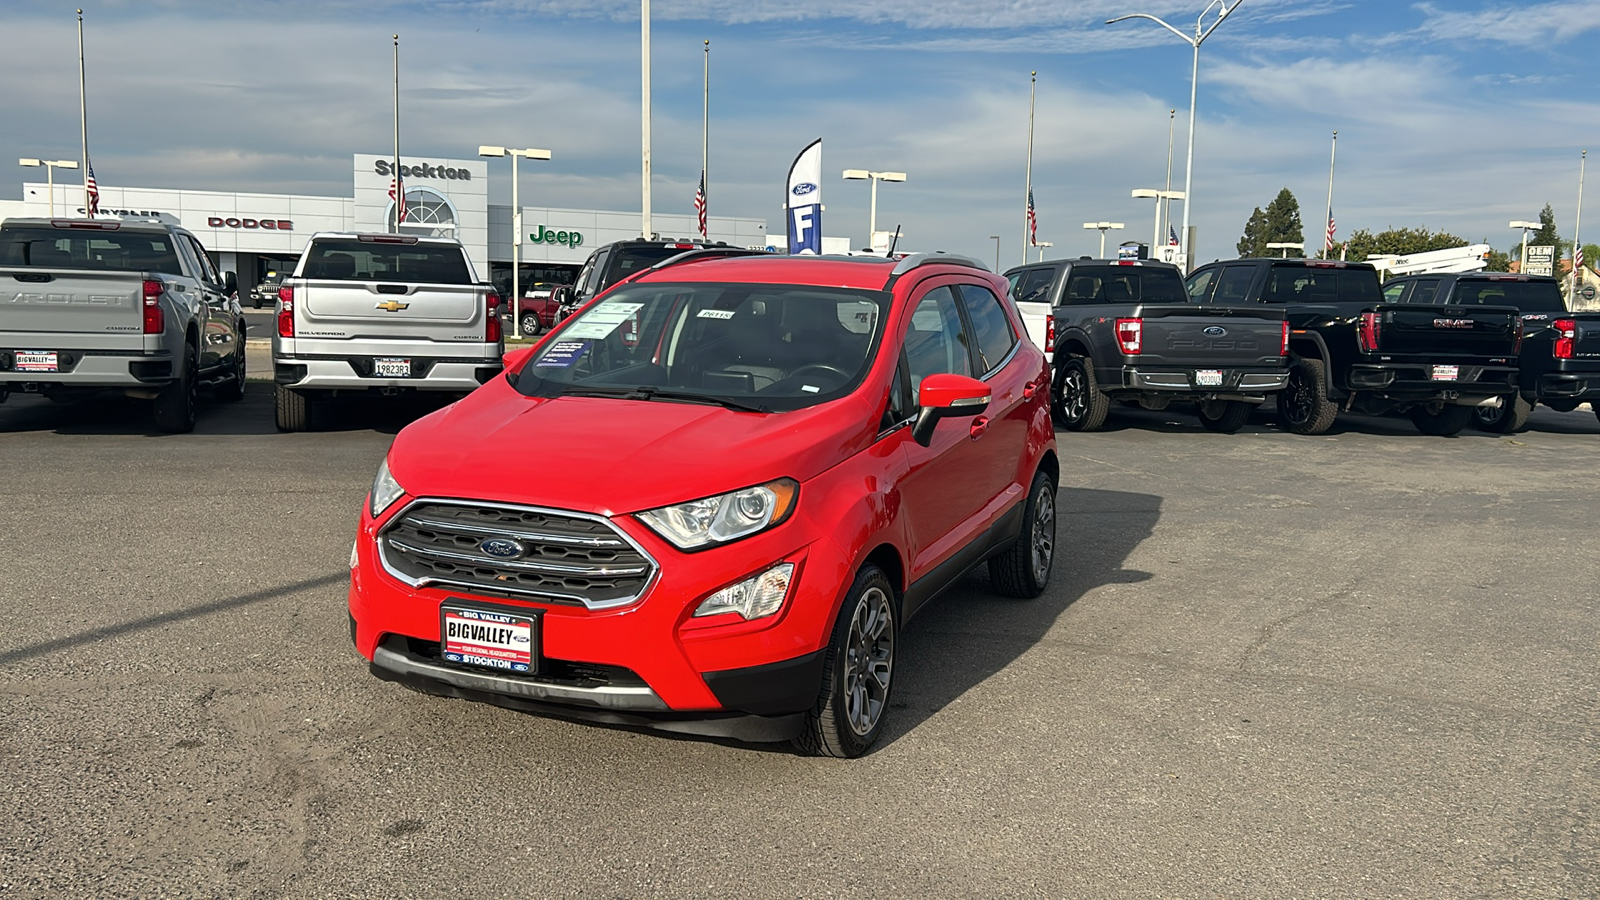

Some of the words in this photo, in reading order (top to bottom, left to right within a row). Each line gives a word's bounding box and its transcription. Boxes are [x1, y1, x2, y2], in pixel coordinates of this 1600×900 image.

[374, 159, 472, 181] Stockton
[207, 216, 294, 230] DODGE
[793, 205, 815, 254] F
[529, 224, 583, 249] Jeep
[1528, 247, 1552, 256] OEM
[1433, 318, 1474, 329] GMC
[1167, 340, 1259, 351] F-150
[487, 541, 513, 555] Ford
[463, 611, 479, 619] BIG
[480, 613, 511, 623] VALLEY
[448, 621, 513, 645] BIGVALLEY
[462, 654, 511, 669] STOCKTON
